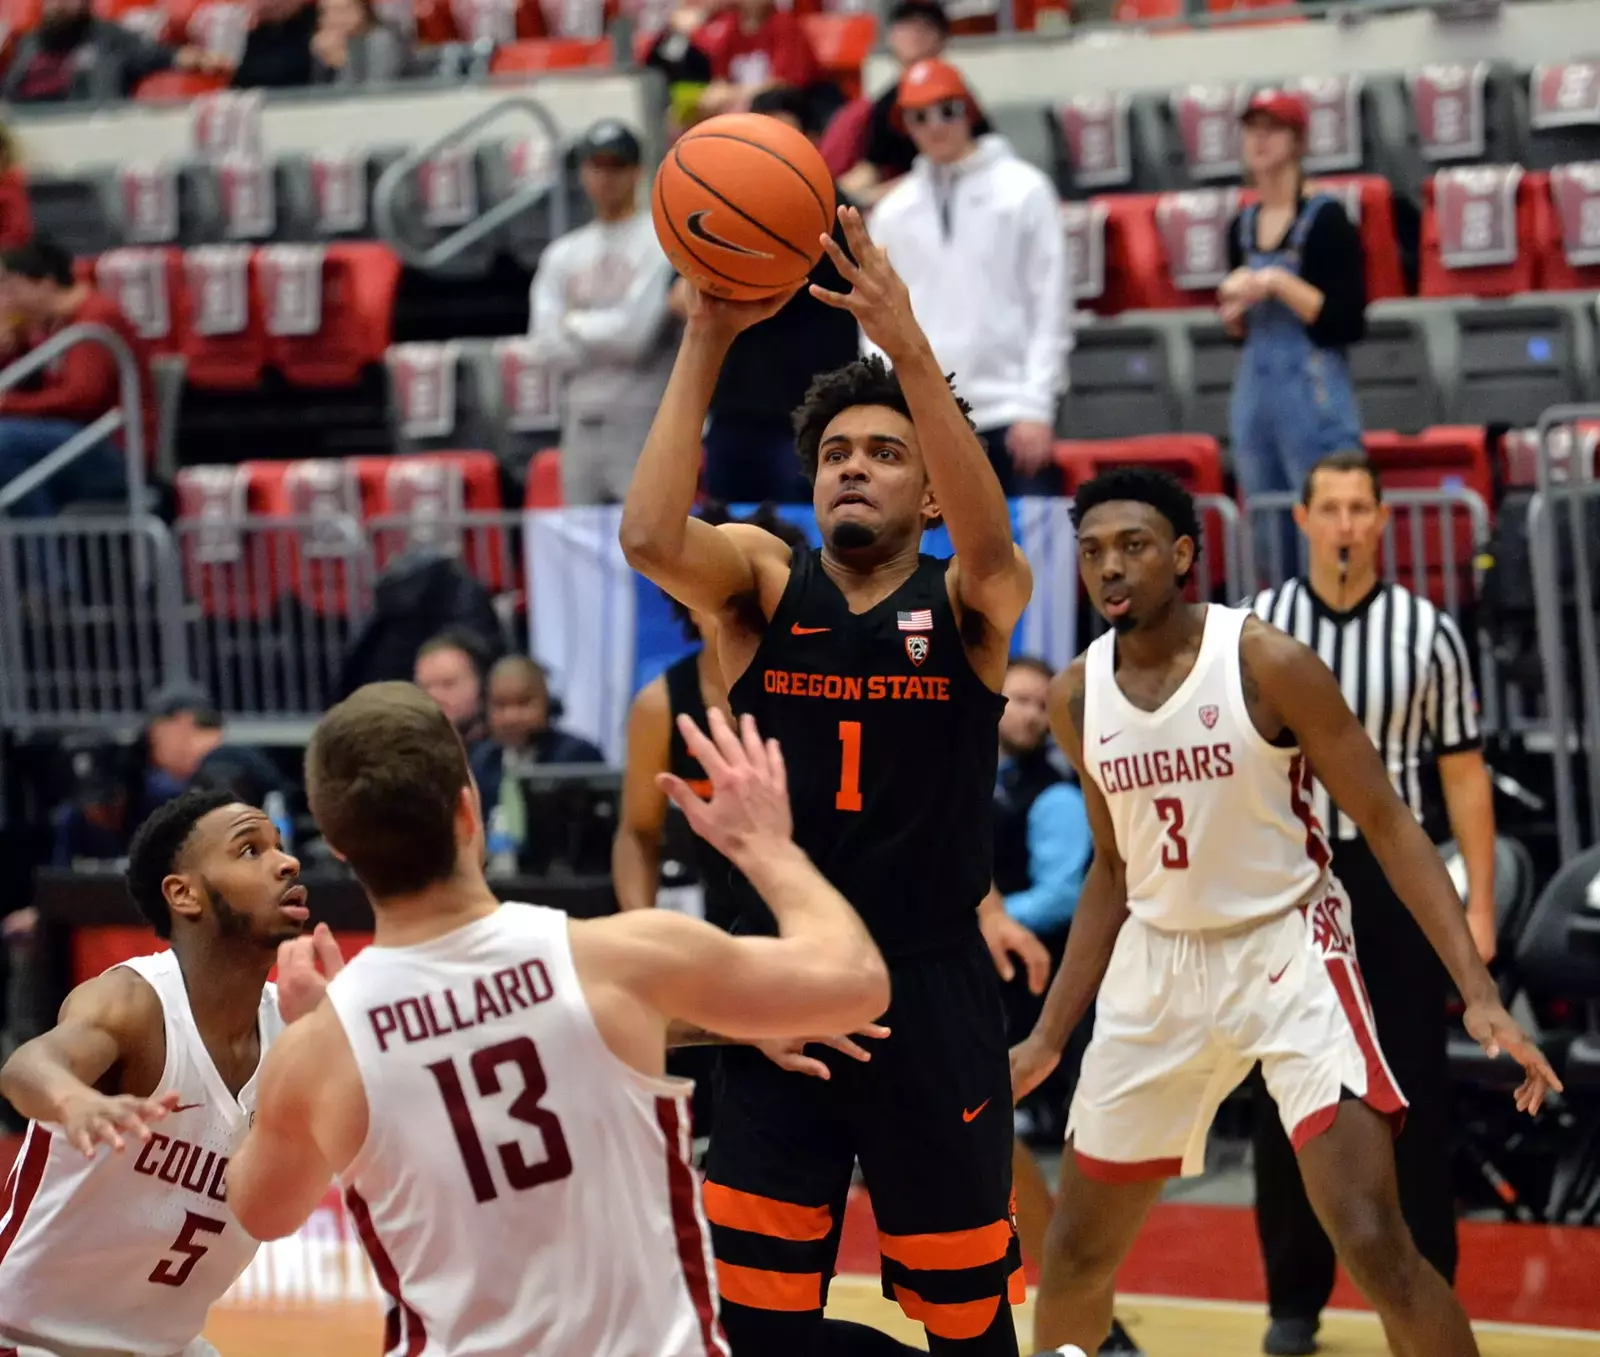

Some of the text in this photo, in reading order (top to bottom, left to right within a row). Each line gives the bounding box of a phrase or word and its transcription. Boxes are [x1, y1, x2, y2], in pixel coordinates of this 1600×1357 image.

[764, 670, 950, 701] OREGON STATE
[912, 648, 924, 660] 12
[835, 721, 862, 812] 1
[1099, 742, 1235, 794] COUGARS
[1153, 796, 1190, 870] 3
[368, 958, 554, 1053] POLLARD
[422, 1036, 573, 1205] 13
[133, 1132, 230, 1203] COUG
[148, 1207, 227, 1287] 5
